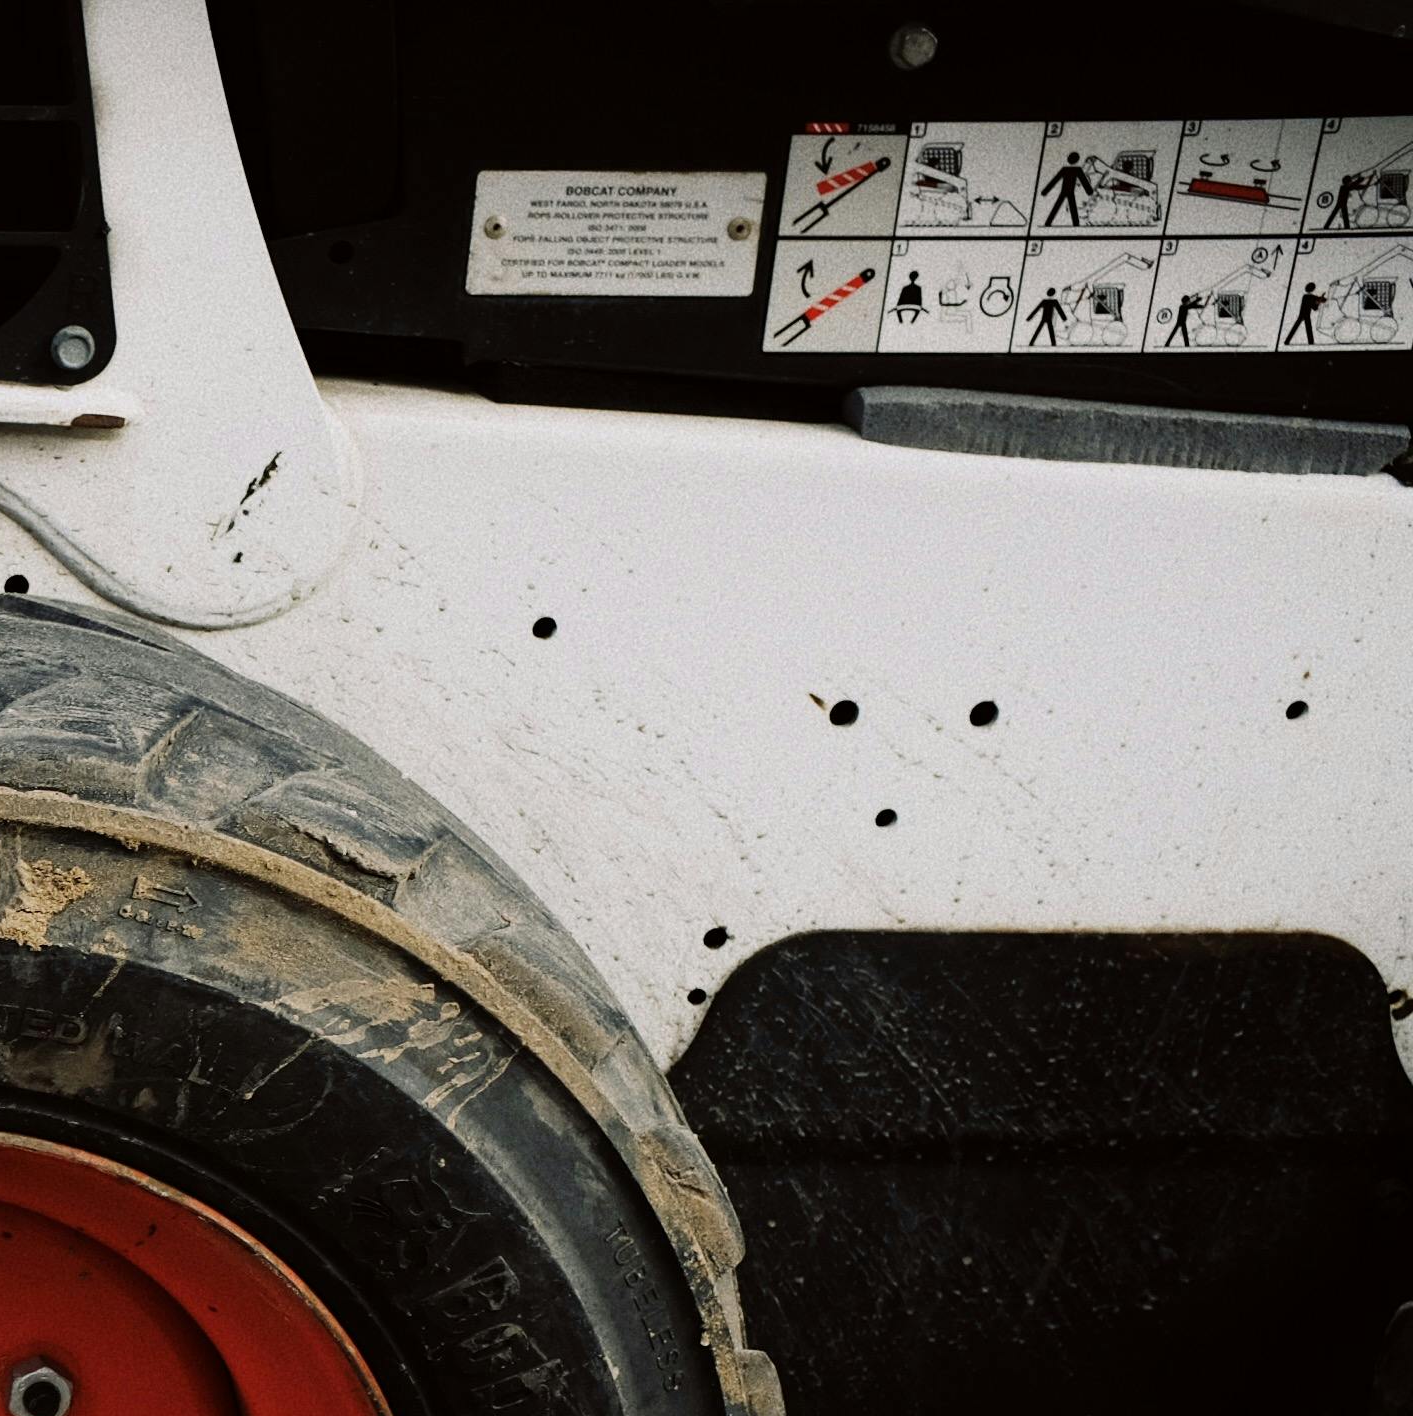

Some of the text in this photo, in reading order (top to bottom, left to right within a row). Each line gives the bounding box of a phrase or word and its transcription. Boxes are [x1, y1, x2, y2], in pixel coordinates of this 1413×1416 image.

[565, 186, 677, 196] BOBCAT COMPANY
[530, 200, 554, 208] WEST
[590, 200, 621, 208] NORTH
[622, 200, 657, 209] DAKOTA
[602, 212, 656, 220] PROTECTIVE
[658, 213, 709, 221] STRUCTURE
[575, 236, 610, 244] OBJECT
[611, 236, 665, 244] PROTECTIVE
[667, 236, 719, 244] STRUCTURE
[628, 248, 654, 256] LEVEL
[500, 259, 546, 267] CERTIFIED
[547, 259, 566, 267] FOR
[607, 259, 650, 268] COMPACT
[651, 260, 687, 268] LOADER
[689, 260, 725, 268] MODELS
[521, 271, 535, 279] UP
[536, 271, 548, 279] TO
[549, 271, 593, 279] MAXIMUM
[590, 1219, 700, 1396] TUBELESS
